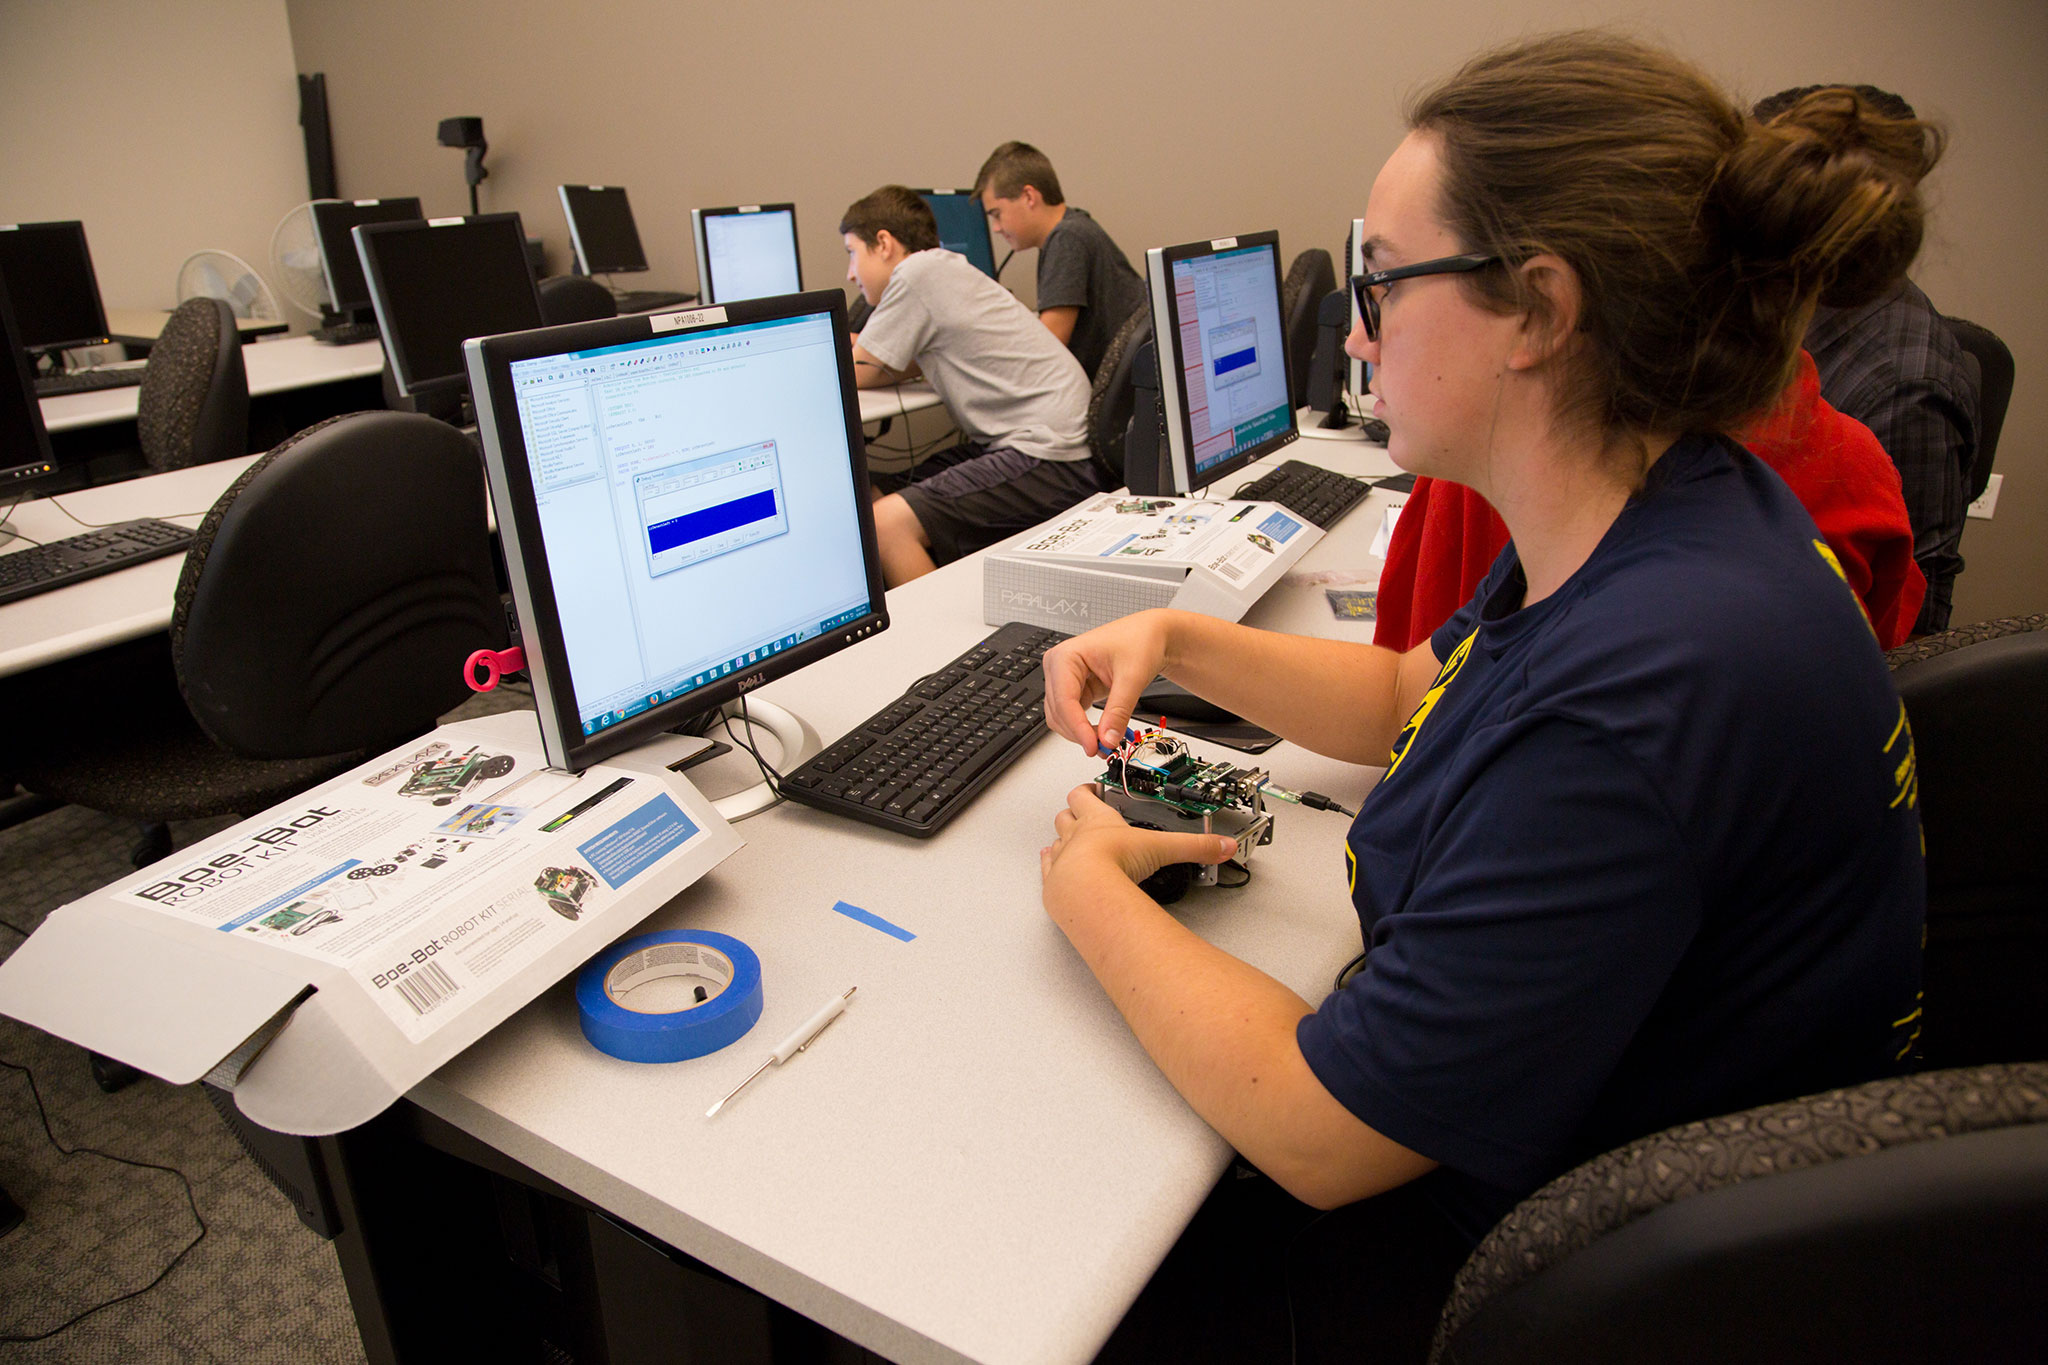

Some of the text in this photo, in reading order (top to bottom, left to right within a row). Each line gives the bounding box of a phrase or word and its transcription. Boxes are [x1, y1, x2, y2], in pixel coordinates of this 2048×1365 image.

[1001, 588, 1078, 616] PARALLAX
[737, 672, 766, 692] DELL
[134, 805, 342, 902] Boe-Bot
[160, 856, 256, 907] ROBOT
[255, 839, 299, 861] KIT
[372, 938, 444, 990] Boe-Bot
[440, 915, 481, 946] ROBOT
[479, 904, 499, 922] KIT
